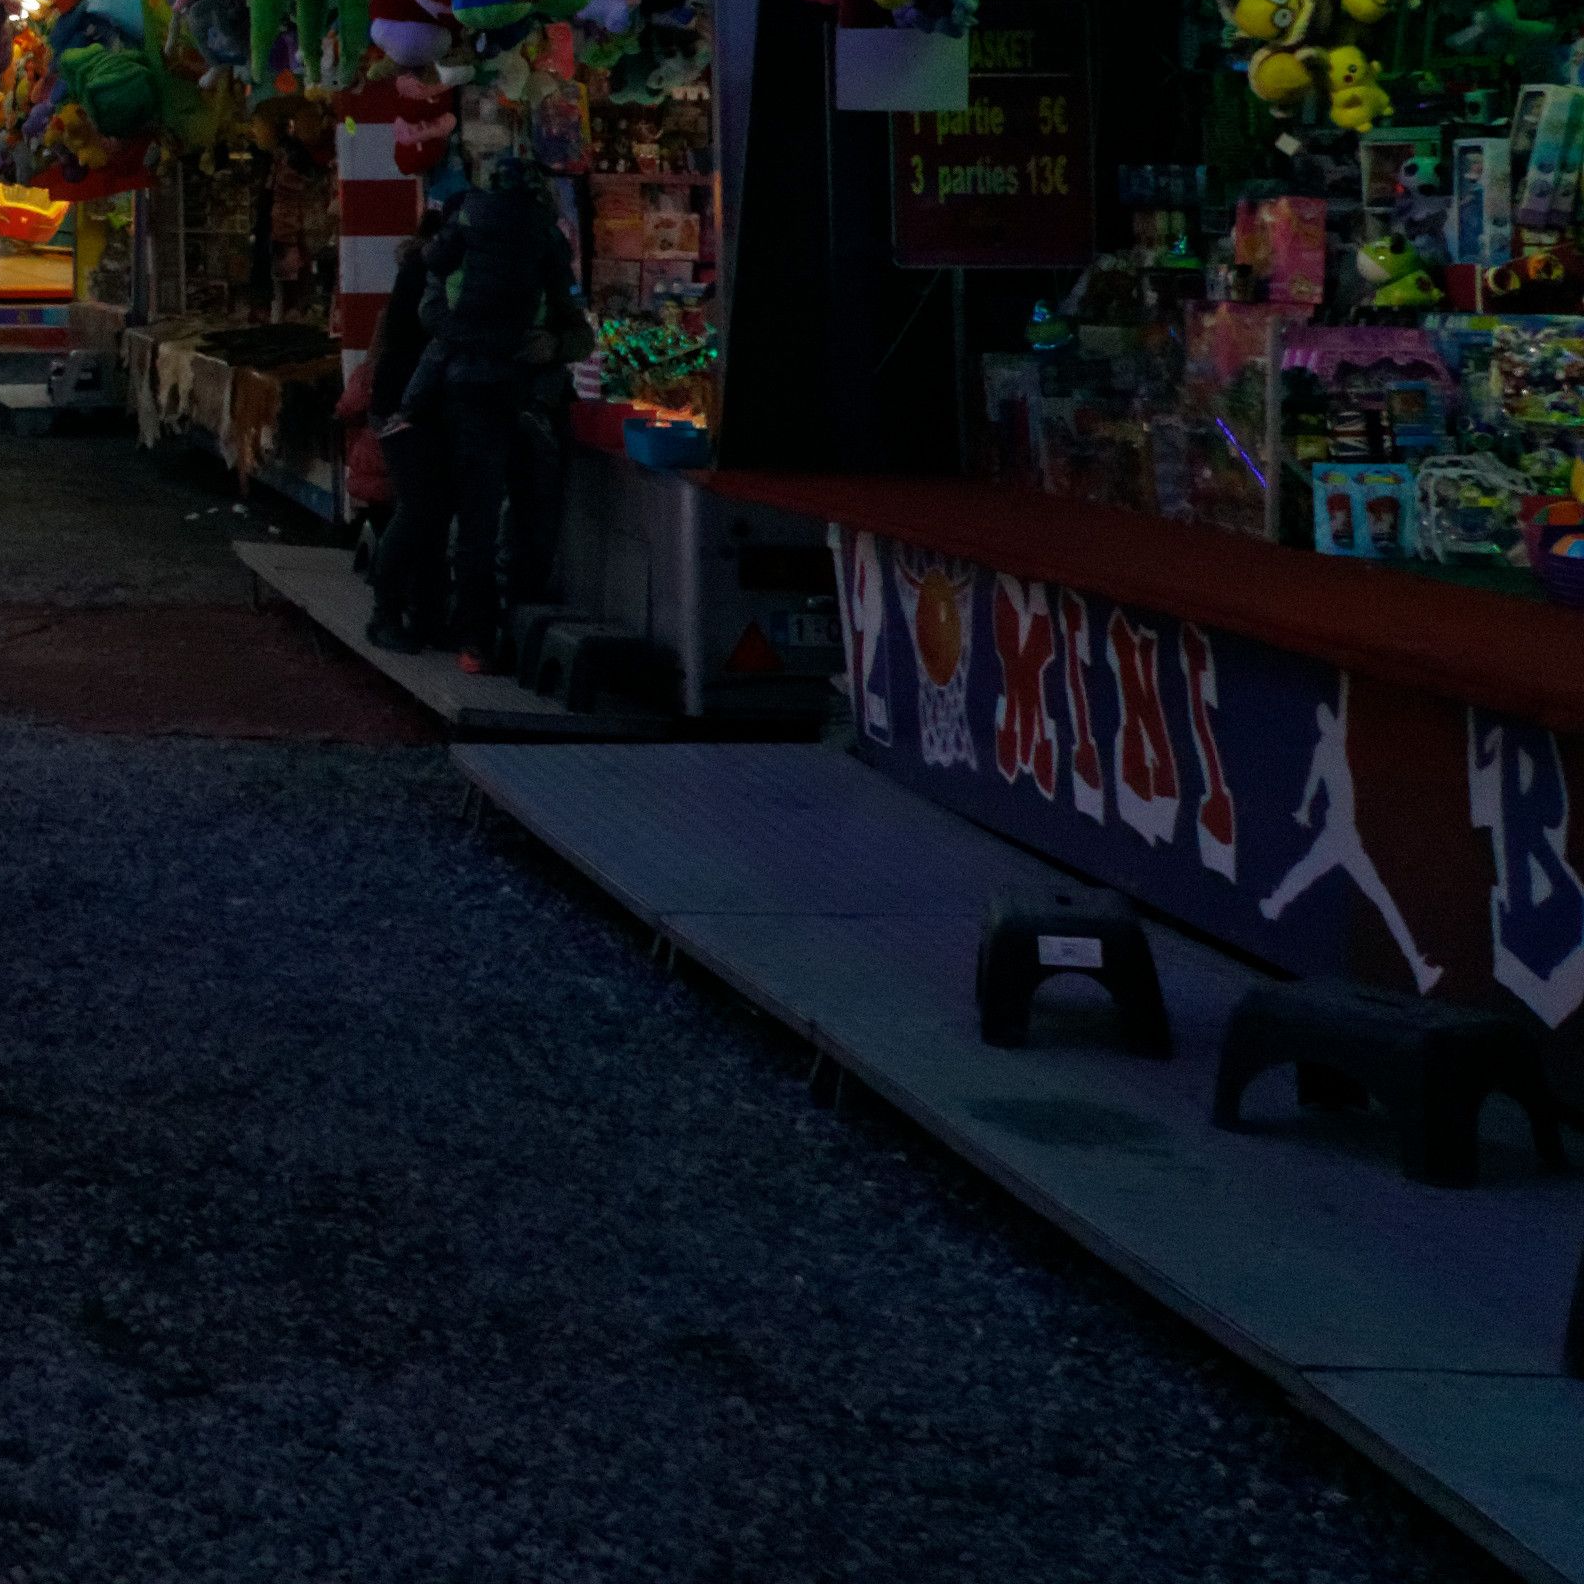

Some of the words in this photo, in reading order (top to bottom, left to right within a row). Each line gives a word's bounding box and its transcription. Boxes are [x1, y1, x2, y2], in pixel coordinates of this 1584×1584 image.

[970, 29, 1037, 68] ASKET
[936, 97, 1007, 145] partie
[1037, 95, 1069, 135] 5€
[910, 154, 926, 196] 3
[937, 155, 1020, 204] parties
[1025, 154, 1070, 196] 13€
